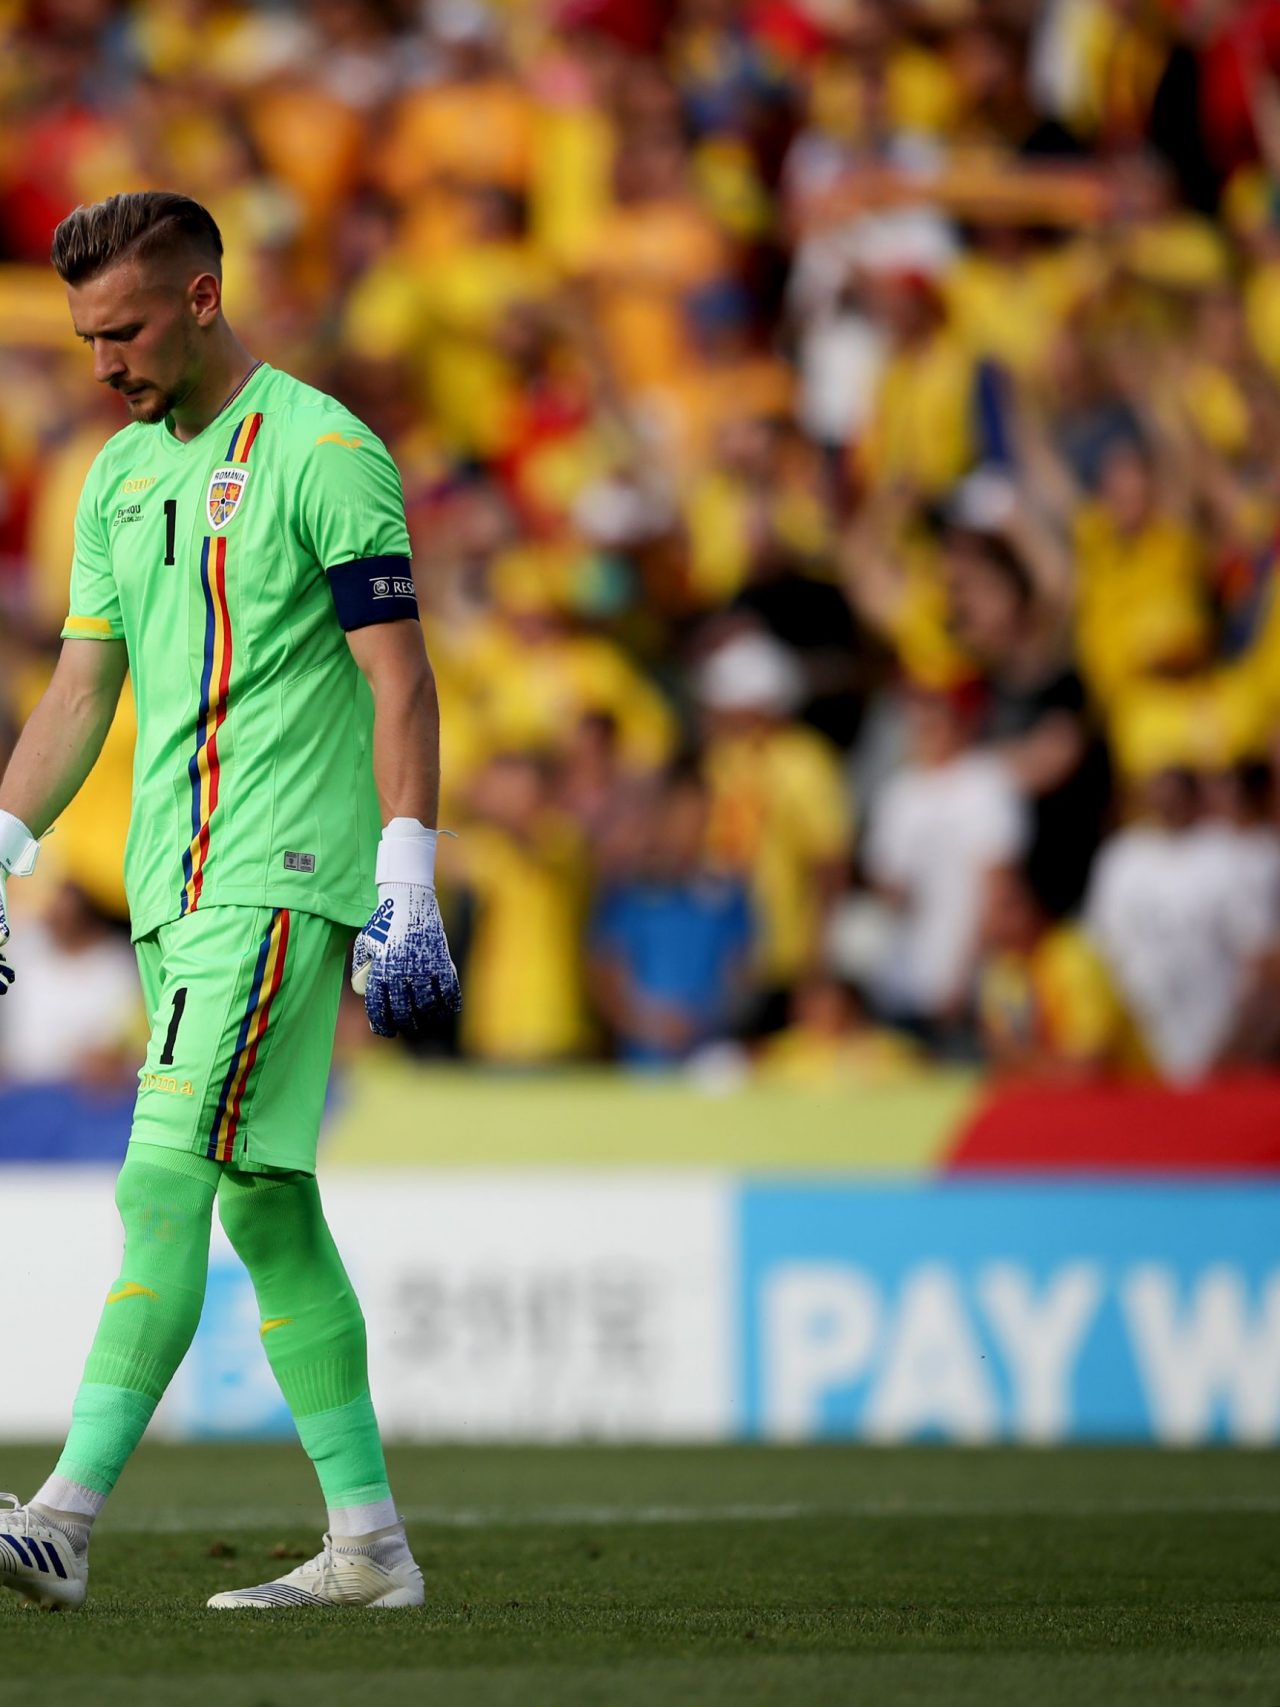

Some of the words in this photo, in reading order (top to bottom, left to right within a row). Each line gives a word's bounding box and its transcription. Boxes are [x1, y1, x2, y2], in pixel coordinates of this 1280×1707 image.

[164, 499, 177, 566] 1
[160, 987, 188, 1065] 1
[765, 1263, 1102, 1443] PAY
[1125, 1265, 1280, 1443] W
